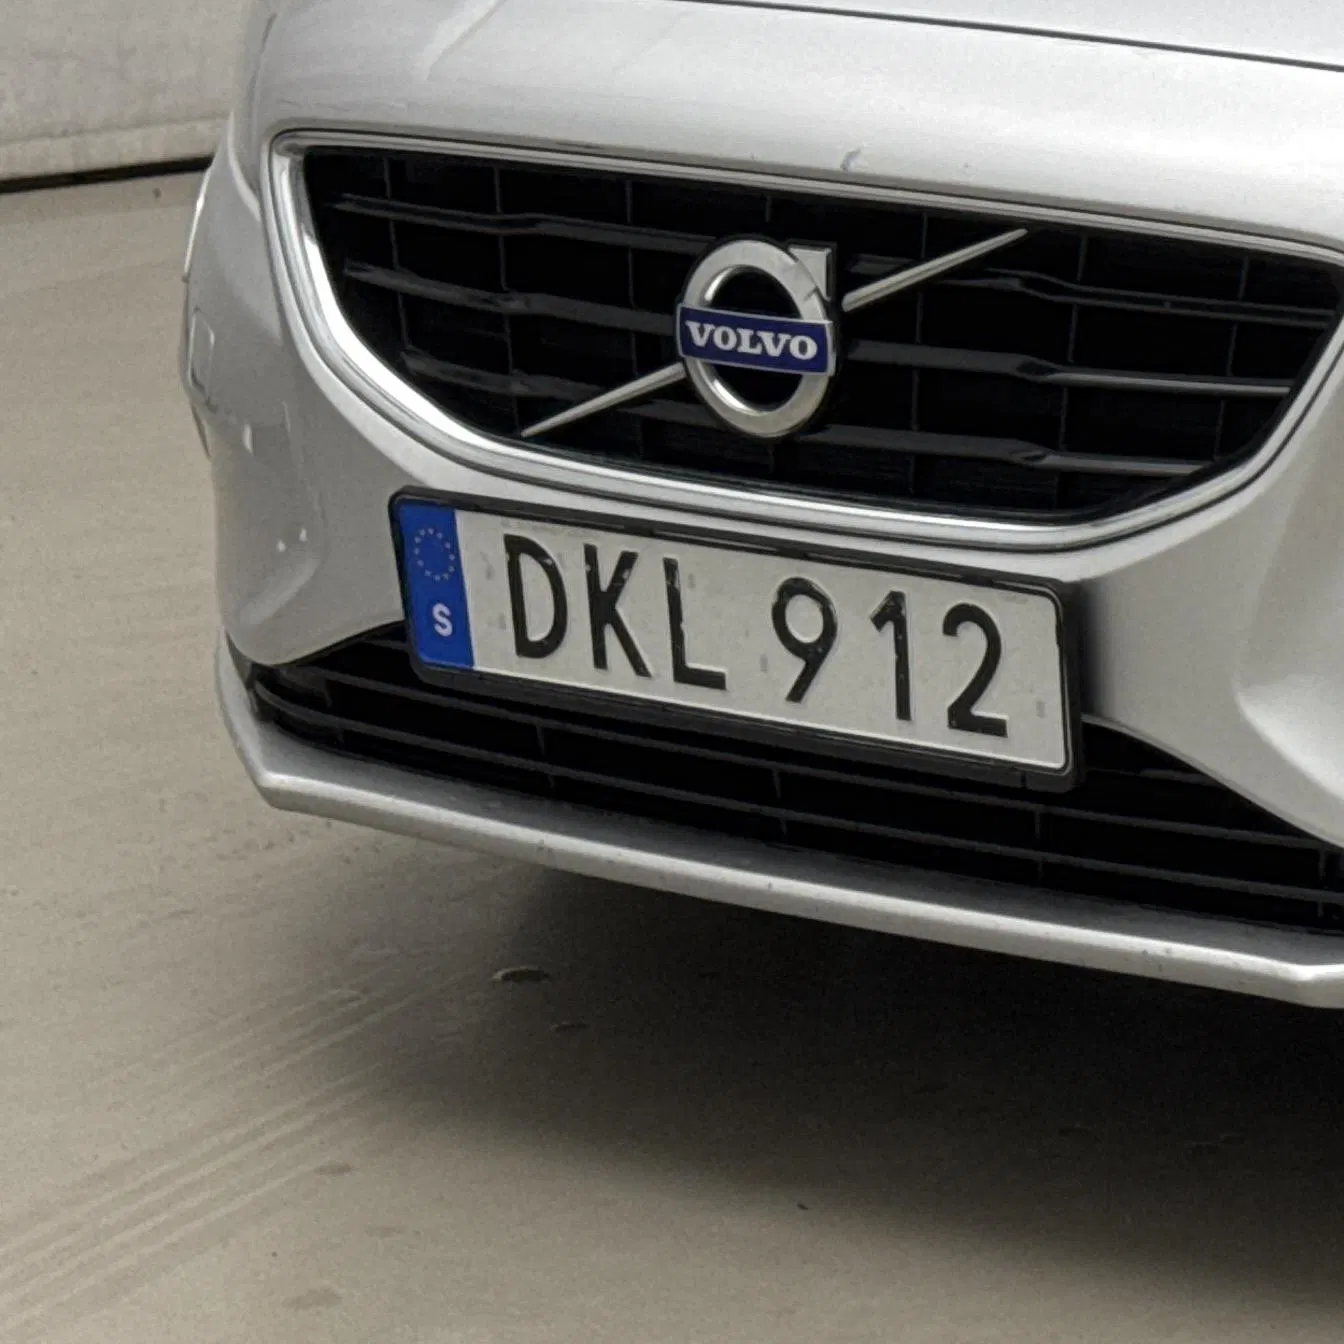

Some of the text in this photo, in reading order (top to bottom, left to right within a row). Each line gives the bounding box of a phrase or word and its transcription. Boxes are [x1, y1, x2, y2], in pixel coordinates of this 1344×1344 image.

[685, 320, 818, 360] VOLVO
[431, 603, 453, 636] S
[503, 534, 1008, 738] DKL 912
